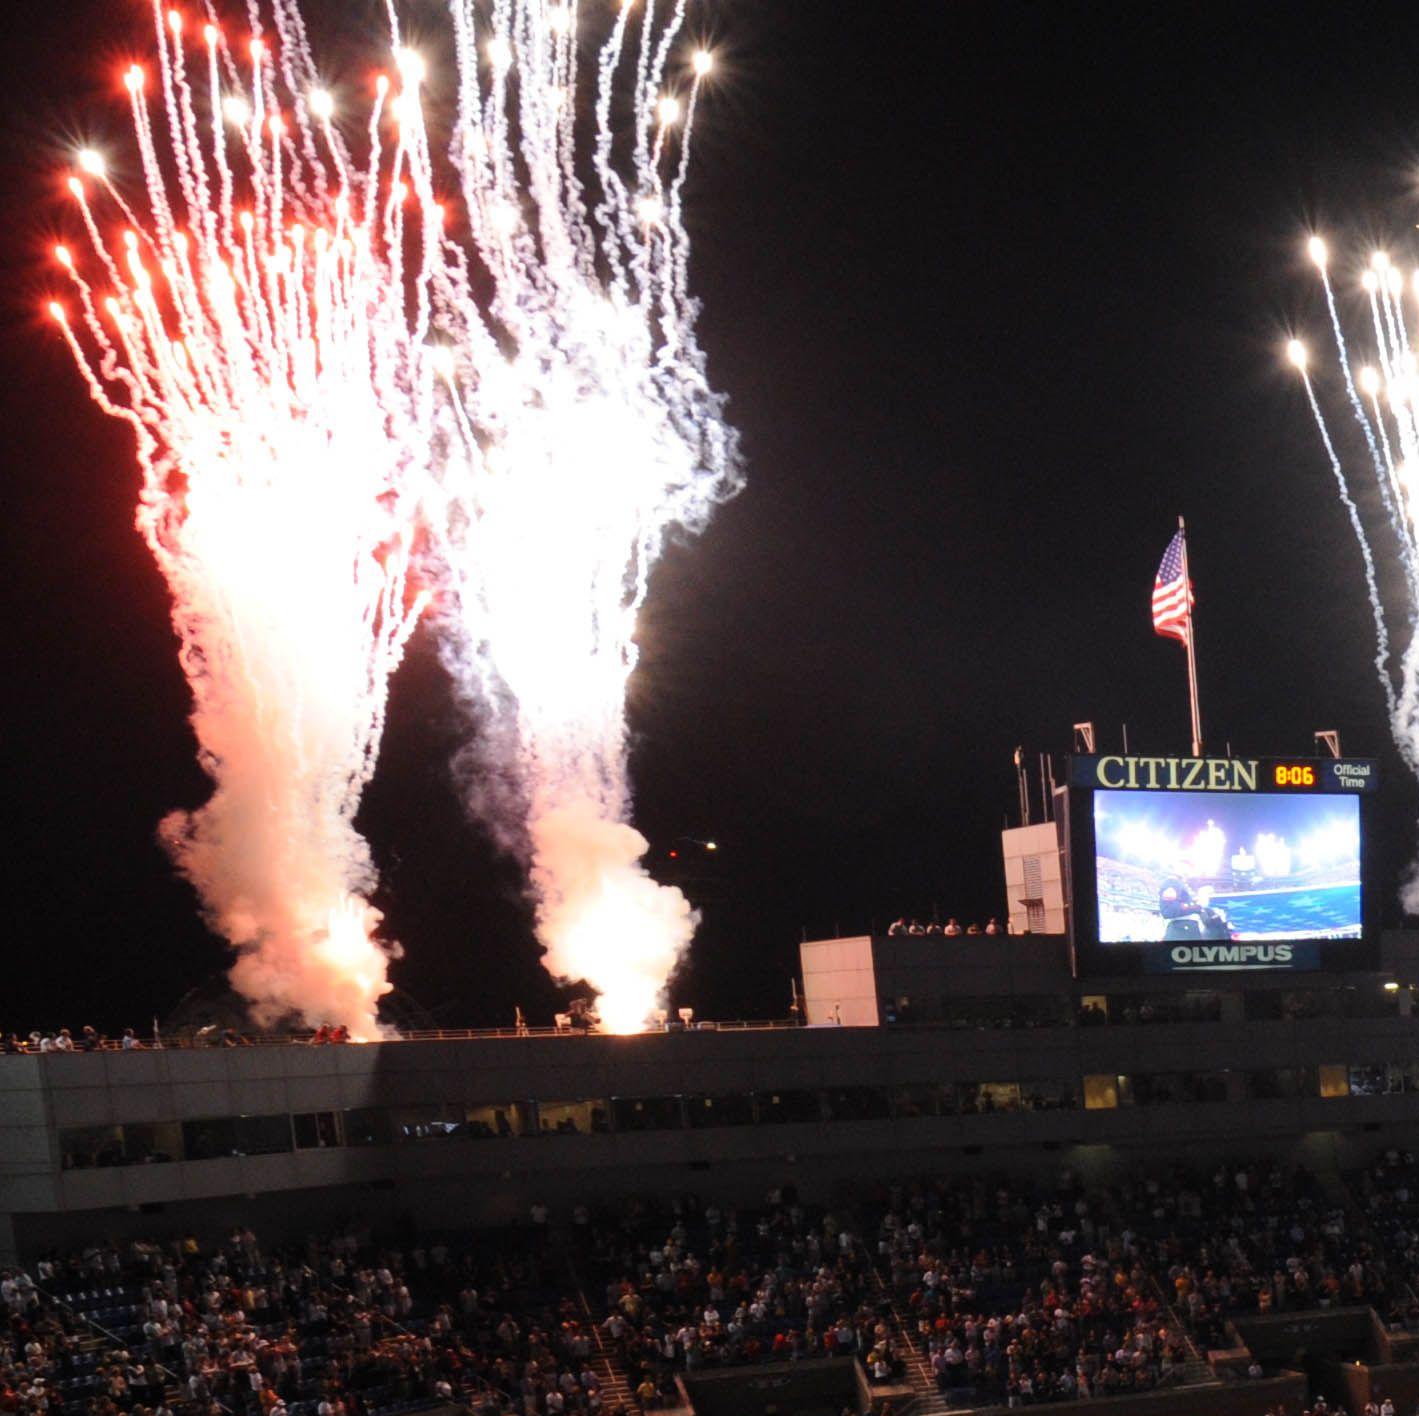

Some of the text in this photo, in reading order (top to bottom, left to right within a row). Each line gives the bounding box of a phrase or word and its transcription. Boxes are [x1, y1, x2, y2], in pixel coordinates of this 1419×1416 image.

[1096, 756, 1259, 791] CITIZEN
[1275, 765, 1314, 786] 8:06
[1334, 763, 1371, 776] Official
[1338, 776, 1366, 789] Time
[1171, 945, 1293, 964] OLYMPUS
